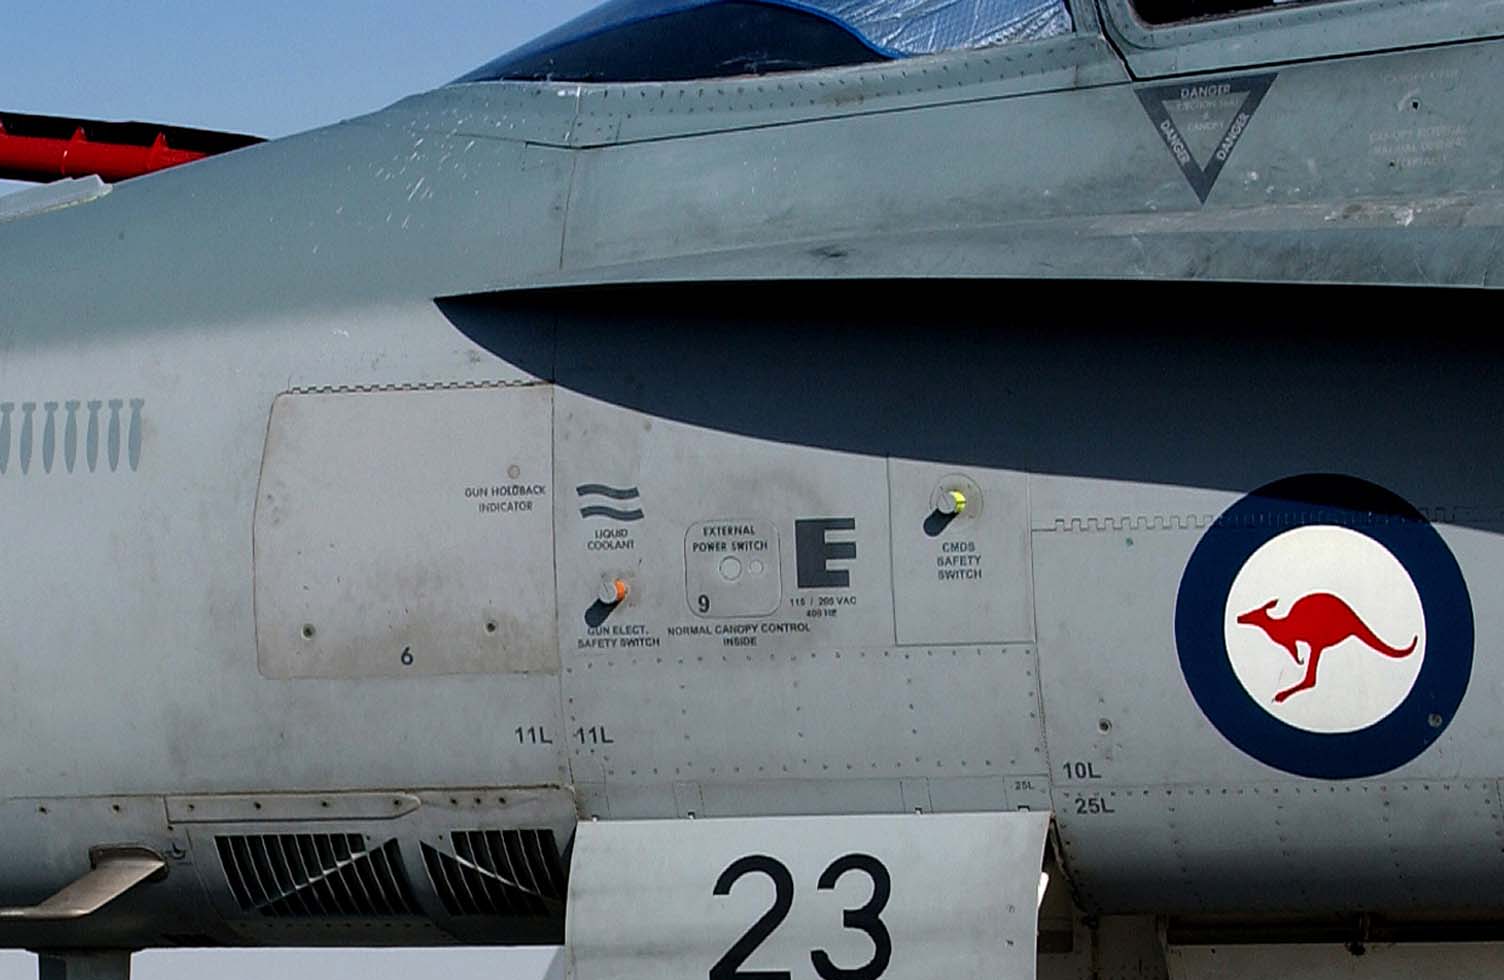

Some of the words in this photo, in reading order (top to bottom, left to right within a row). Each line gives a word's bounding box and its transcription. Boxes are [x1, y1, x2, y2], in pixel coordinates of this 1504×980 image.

[1160, 119, 1191, 165] DANGER
[464, 486, 488, 498] GUN
[491, 484, 546, 497] HOLDBACK
[478, 501, 533, 513] INDICATOR
[594, 528, 628, 539] LIQUID
[702, 525, 756, 537] EXTERNAL
[587, 539, 635, 550] COOLANT
[692, 542, 727, 553] POWER
[731, 540, 768, 551] SWITCH
[795, 517, 857, 588] E
[936, 555, 982, 567] SAFETY
[937, 569, 982, 580] SWITCH
[698, 594, 710, 613] 9
[836, 595, 857, 606] VAC
[587, 625, 610, 636] GUN
[612, 625, 649, 636] ELECT.
[667, 625, 713, 637] NORMAL
[715, 624, 757, 636] CANOPY
[760, 622, 811, 634] CONTROL
[577, 638, 616, 649] SAFETY
[619, 637, 660, 649] SWITCH
[723, 636, 757, 647] INSIDE
[400, 645, 414, 667] 6
[514, 726, 553, 744] 11L
[577, 725, 614, 744] 11L
[1063, 762, 1102, 779] 10L
[1014, 781, 1035, 791] 25L
[1075, 797, 1115, 814] 25L
